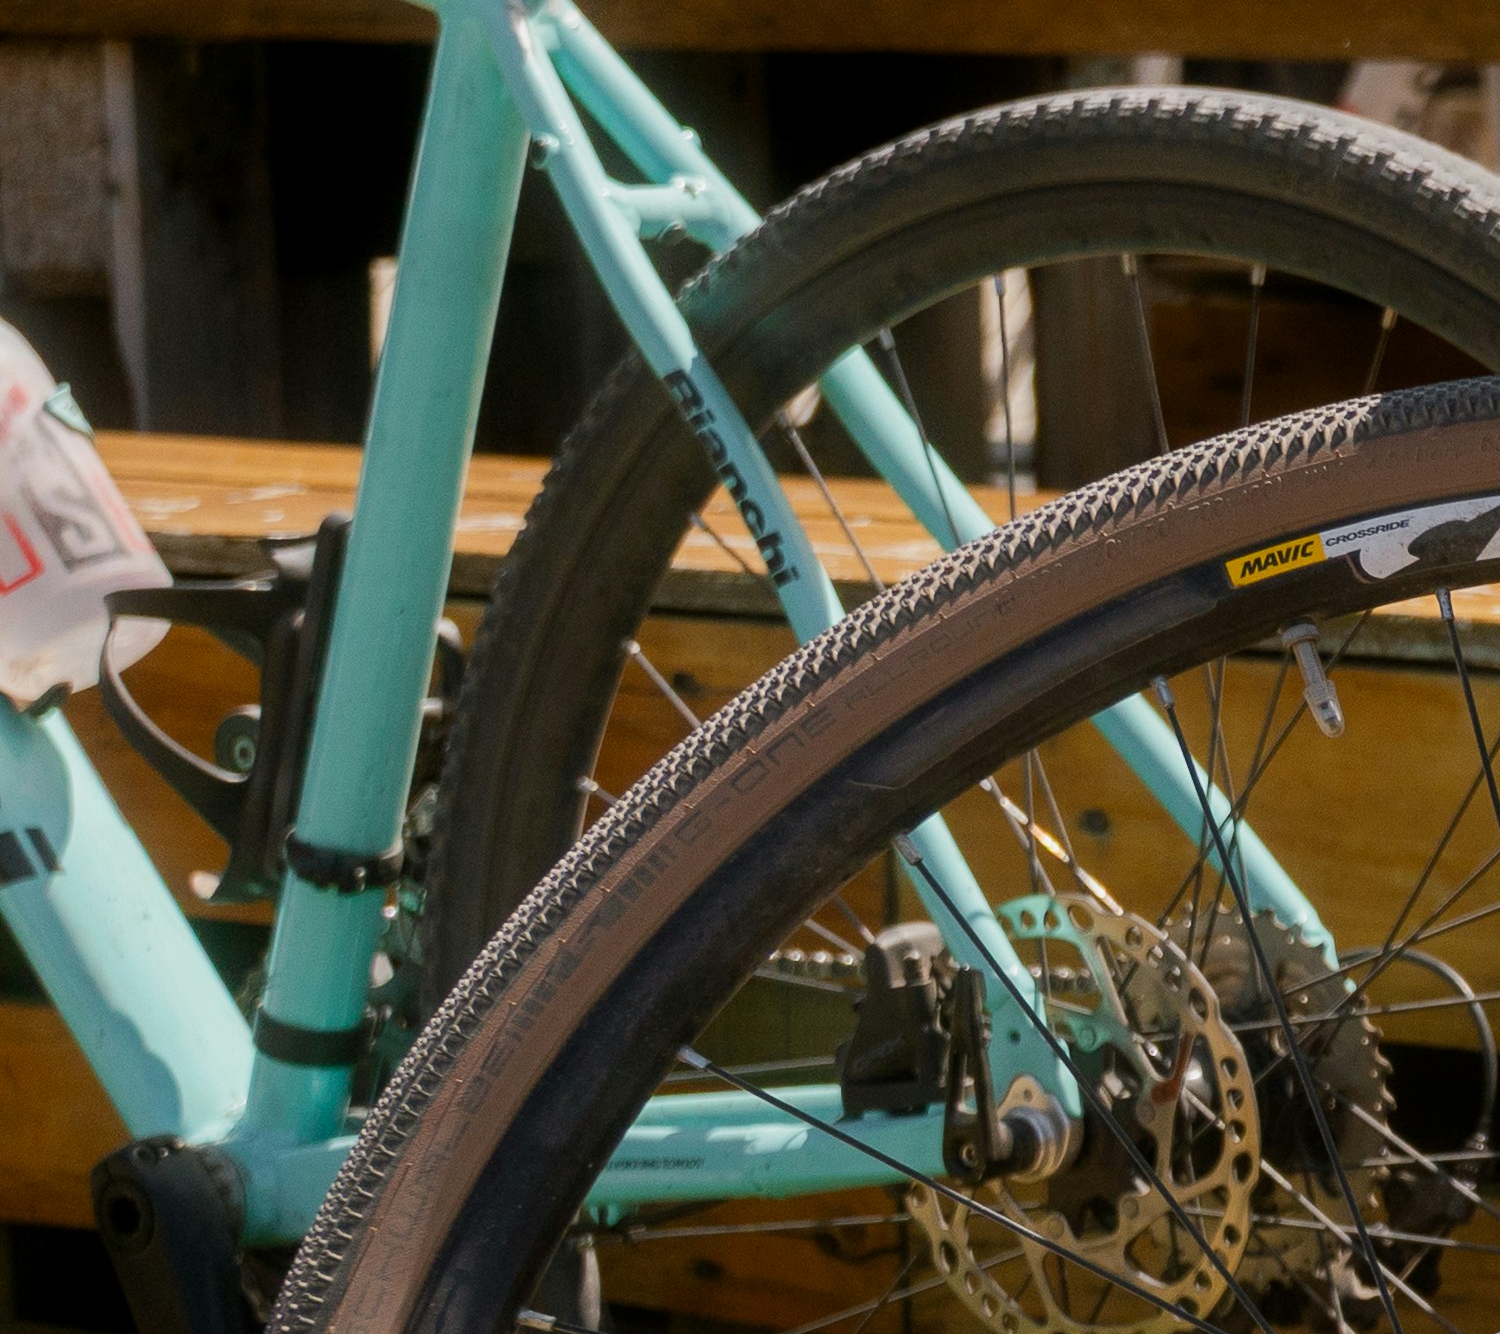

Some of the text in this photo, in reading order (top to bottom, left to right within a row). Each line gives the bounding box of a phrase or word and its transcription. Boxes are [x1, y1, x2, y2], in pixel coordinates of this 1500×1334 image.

[663, 369, 800, 588] Bianchi
[1240, 519, 1411, 579] MAVIC CROSSRIDE
